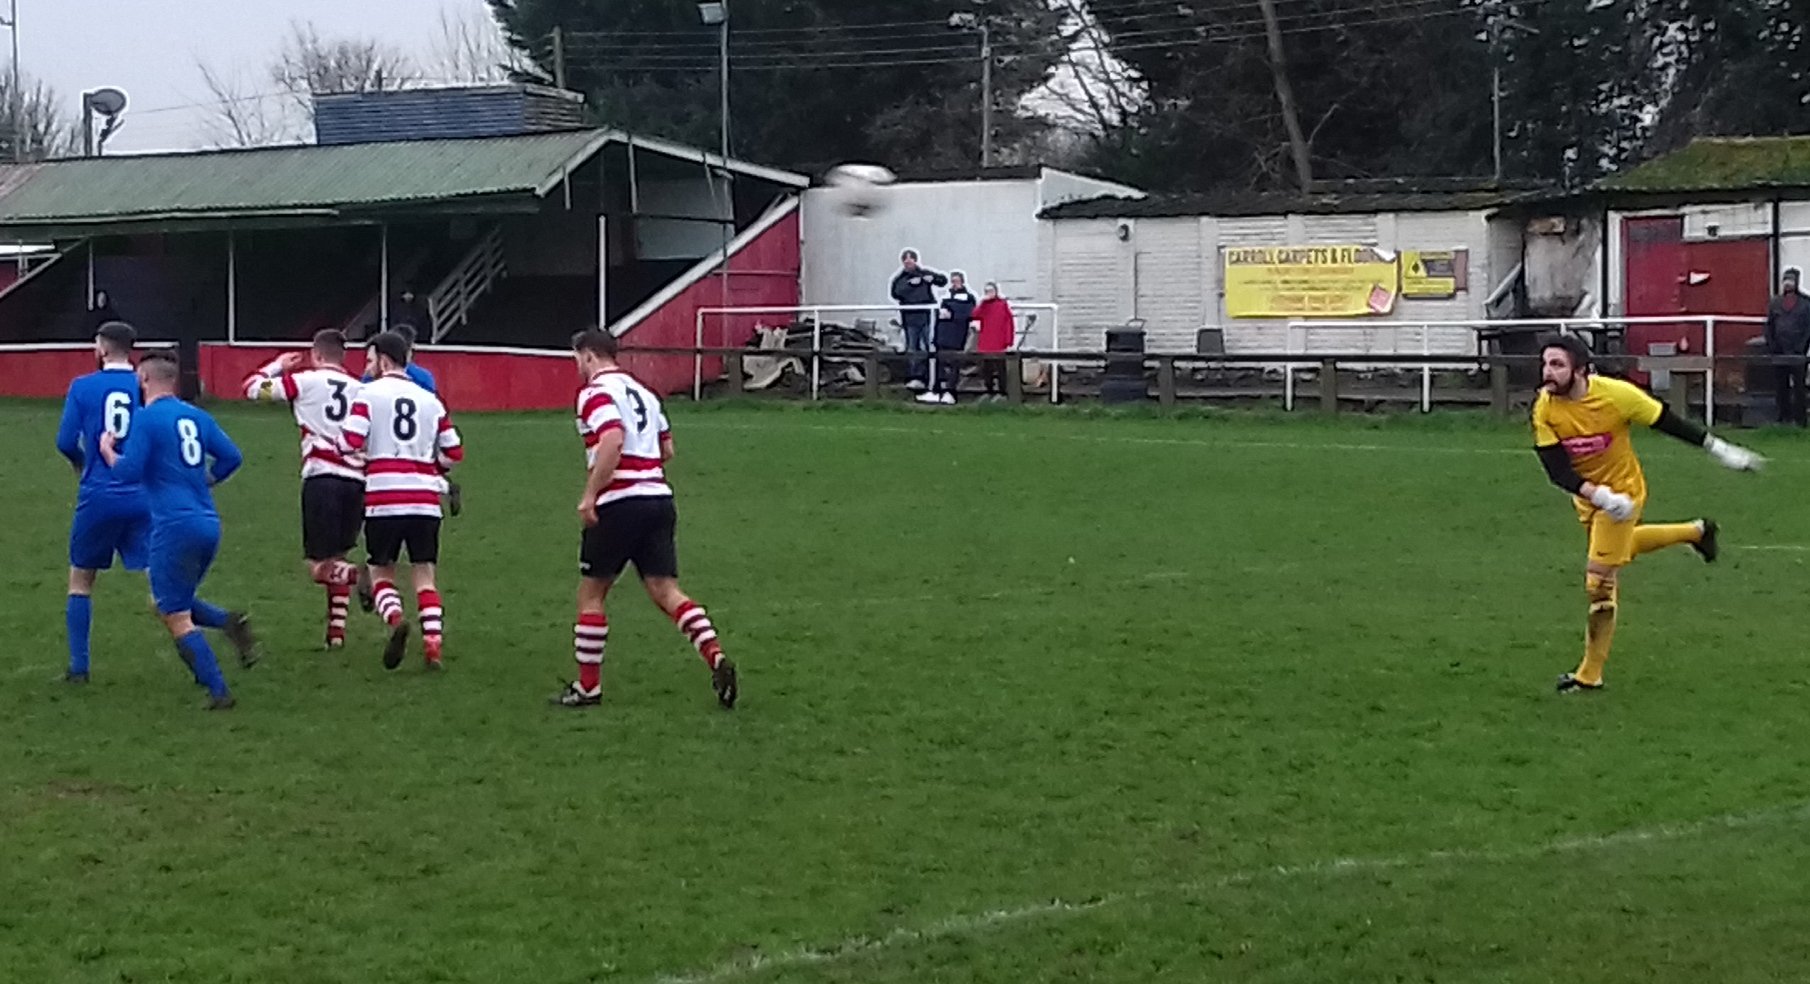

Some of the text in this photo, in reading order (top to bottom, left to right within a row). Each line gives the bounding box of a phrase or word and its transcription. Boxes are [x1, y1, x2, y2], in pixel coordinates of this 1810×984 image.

[1278, 248, 1328, 264] CARPETS
[104, 391, 131, 439] 6
[325, 378, 348, 422] 3
[393, 397, 417, 441] 8
[177, 417, 202, 466] 8
